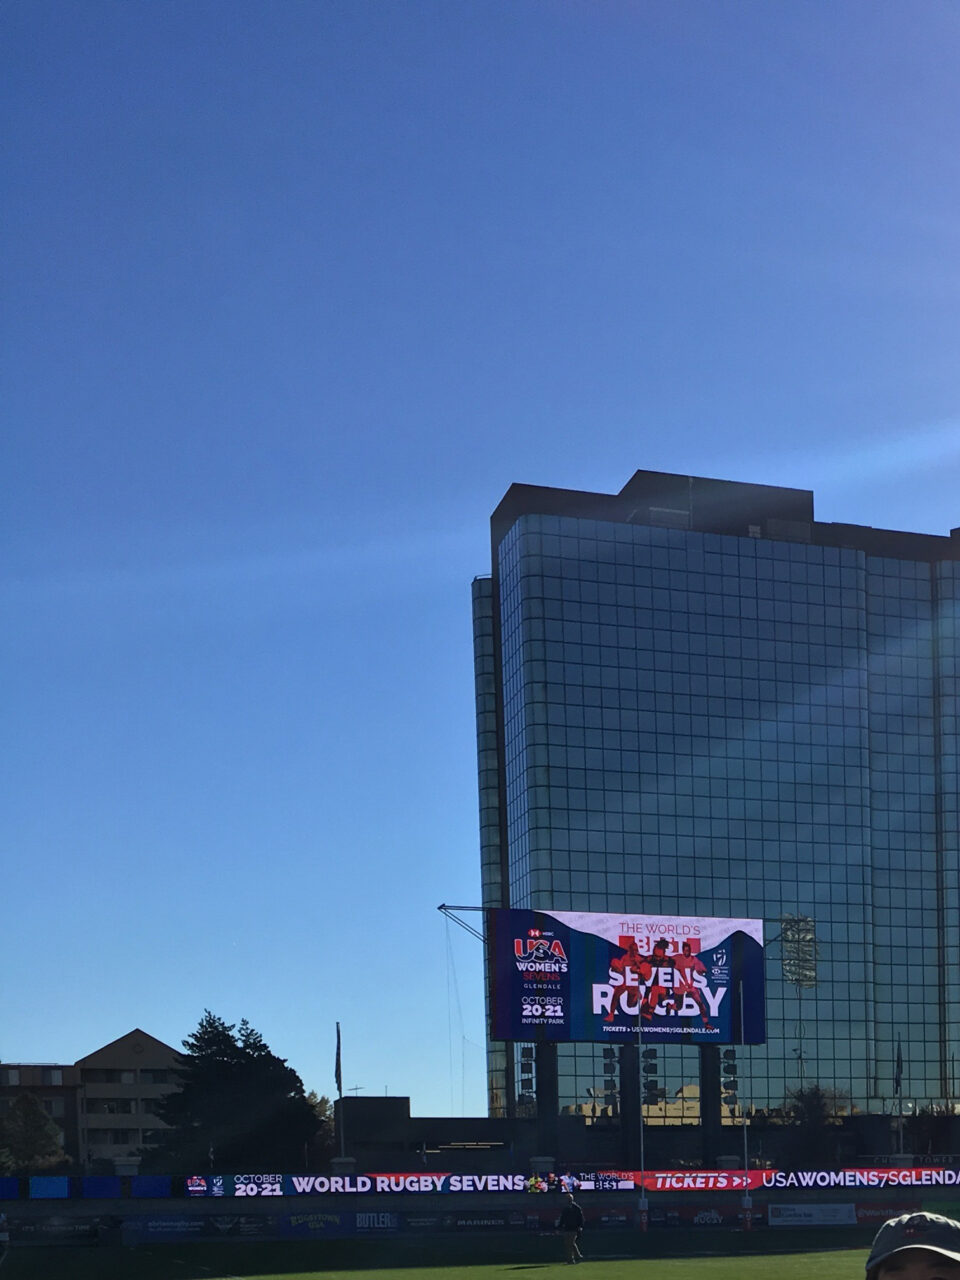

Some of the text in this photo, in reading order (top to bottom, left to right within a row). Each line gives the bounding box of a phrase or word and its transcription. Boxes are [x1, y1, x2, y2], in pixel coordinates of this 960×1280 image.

[619, 922, 701, 935] THE WORLD'S
[514, 939, 568, 963] USA
[516, 962, 568, 972] WOMEN'S
[523, 972, 560, 981] SEVENS
[609, 966, 708, 988] SEVENS
[521, 996, 564, 1005] OCTOBER
[592, 983, 727, 1016] RUGBY
[522, 1005, 564, 1016] 20-21
[234, 1174, 283, 1184] OCTOBER
[579, 1172, 634, 1181] THE WORLD'S
[655, 1173, 729, 1188] TICKETS
[234, 1183, 284, 1196] 20-21
[291, 1174, 525, 1193] WORLD RUGBY SEVENS
[594, 1180, 618, 1190] BEST
[356, 1213, 391, 1228] BUTLER
